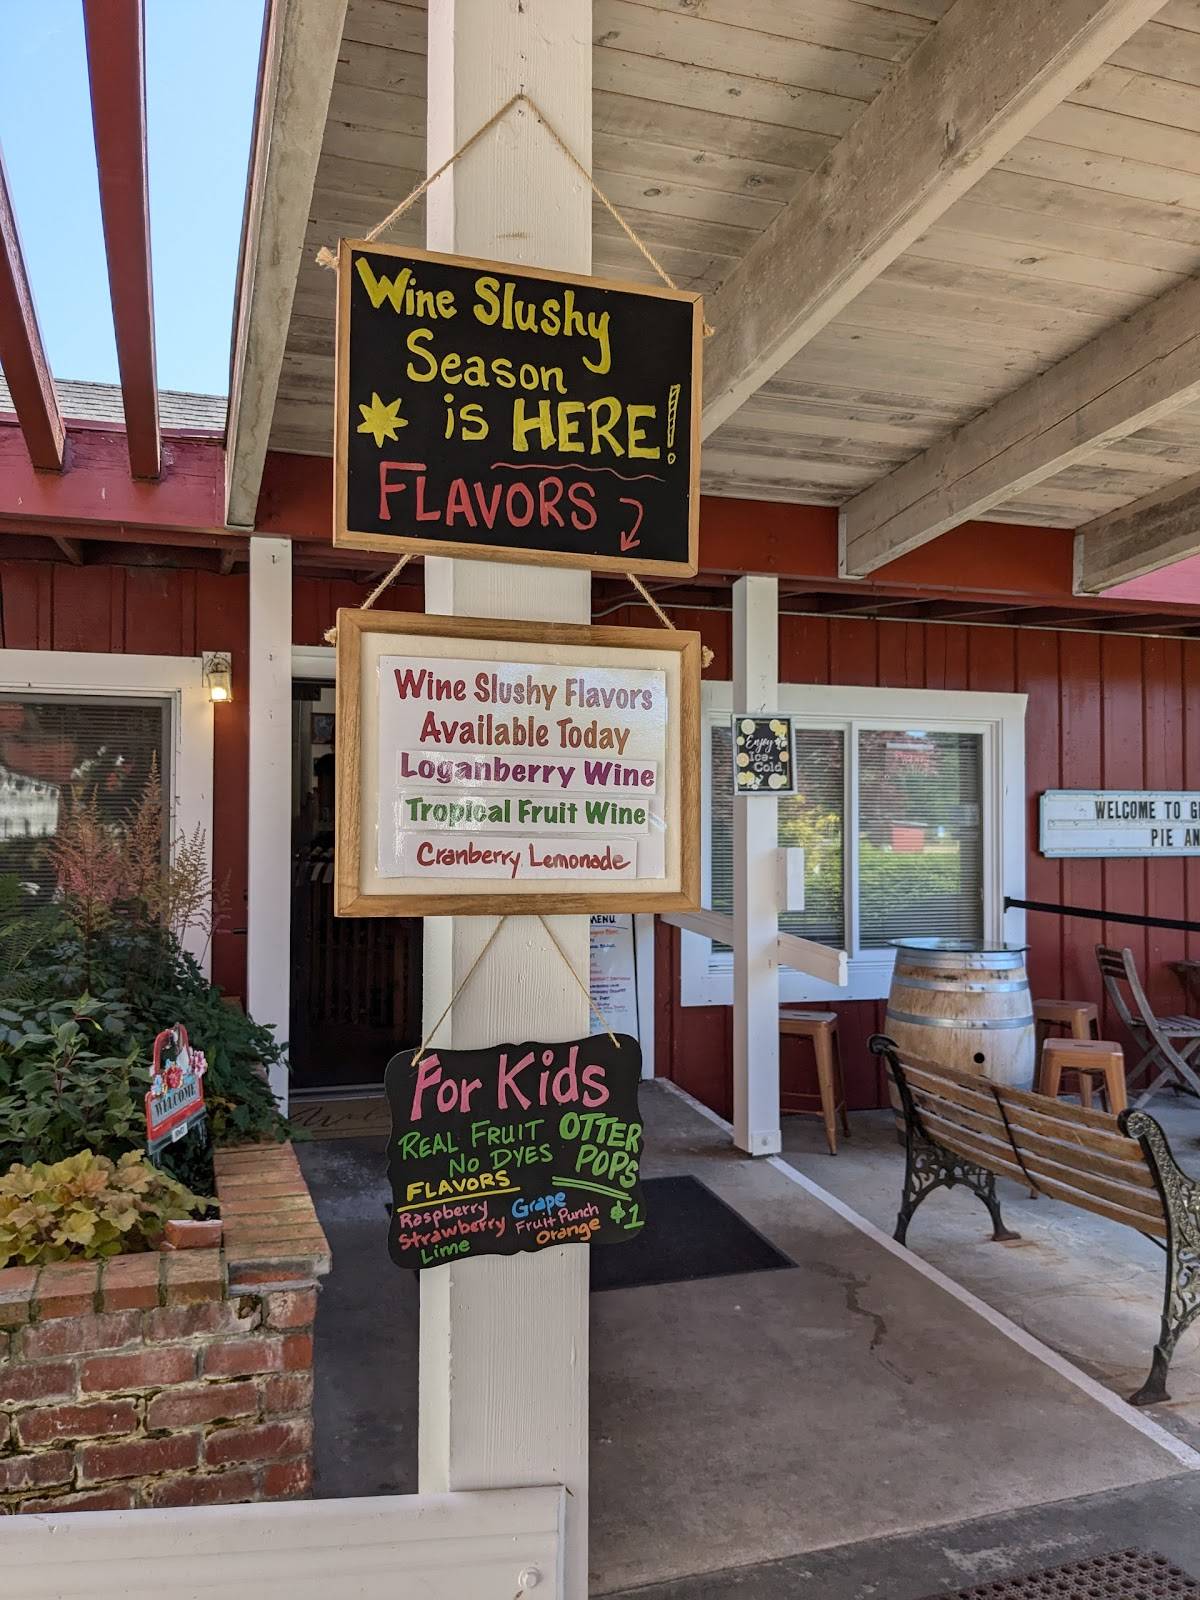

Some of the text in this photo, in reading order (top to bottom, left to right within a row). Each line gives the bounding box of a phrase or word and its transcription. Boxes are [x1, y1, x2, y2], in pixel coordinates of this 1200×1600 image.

[355, 257, 611, 374] Wine Slushy
[406, 328, 567, 394] Season
[444, 384, 681, 464] is HERE!
[379, 461, 597, 530] FLAVORS
[394, 668, 653, 711] Wine Slushy Flavors
[420, 711, 631, 755] Available Today
[400, 752, 655, 788] Loganberry Wine
[753, 762, 782, 773] Cold
[405, 797, 646, 827] Tropical Fruit Wine
[1095, 801, 1156, 819] WELCOME
[1164, 801, 1181, 819] TO
[1151, 829, 1173, 847] PIE
[416, 841, 631, 879] Cranberry Lemonade
[410, 1045, 610, 1121] For Kids
[154, 1084, 195, 1117] WELCOME
[398, 1119, 545, 1160] REAL FRUIT
[559, 1111, 642, 1153] OTTER
[490, 1143, 554, 1170] DYES
[575, 1145, 639, 1189] POPS
[406, 1170, 511, 1201] FLAVORS
[400, 1200, 488, 1228] Raspberry
[511, 1191, 566, 1218] Grape
[515, 1202, 599, 1235] Fruit Punch
[610, 1200, 645, 1230] $1
[398, 1216, 506, 1250] Strawberry
[536, 1218, 601, 1245] Orange
[420, 1239, 471, 1265] Lime
